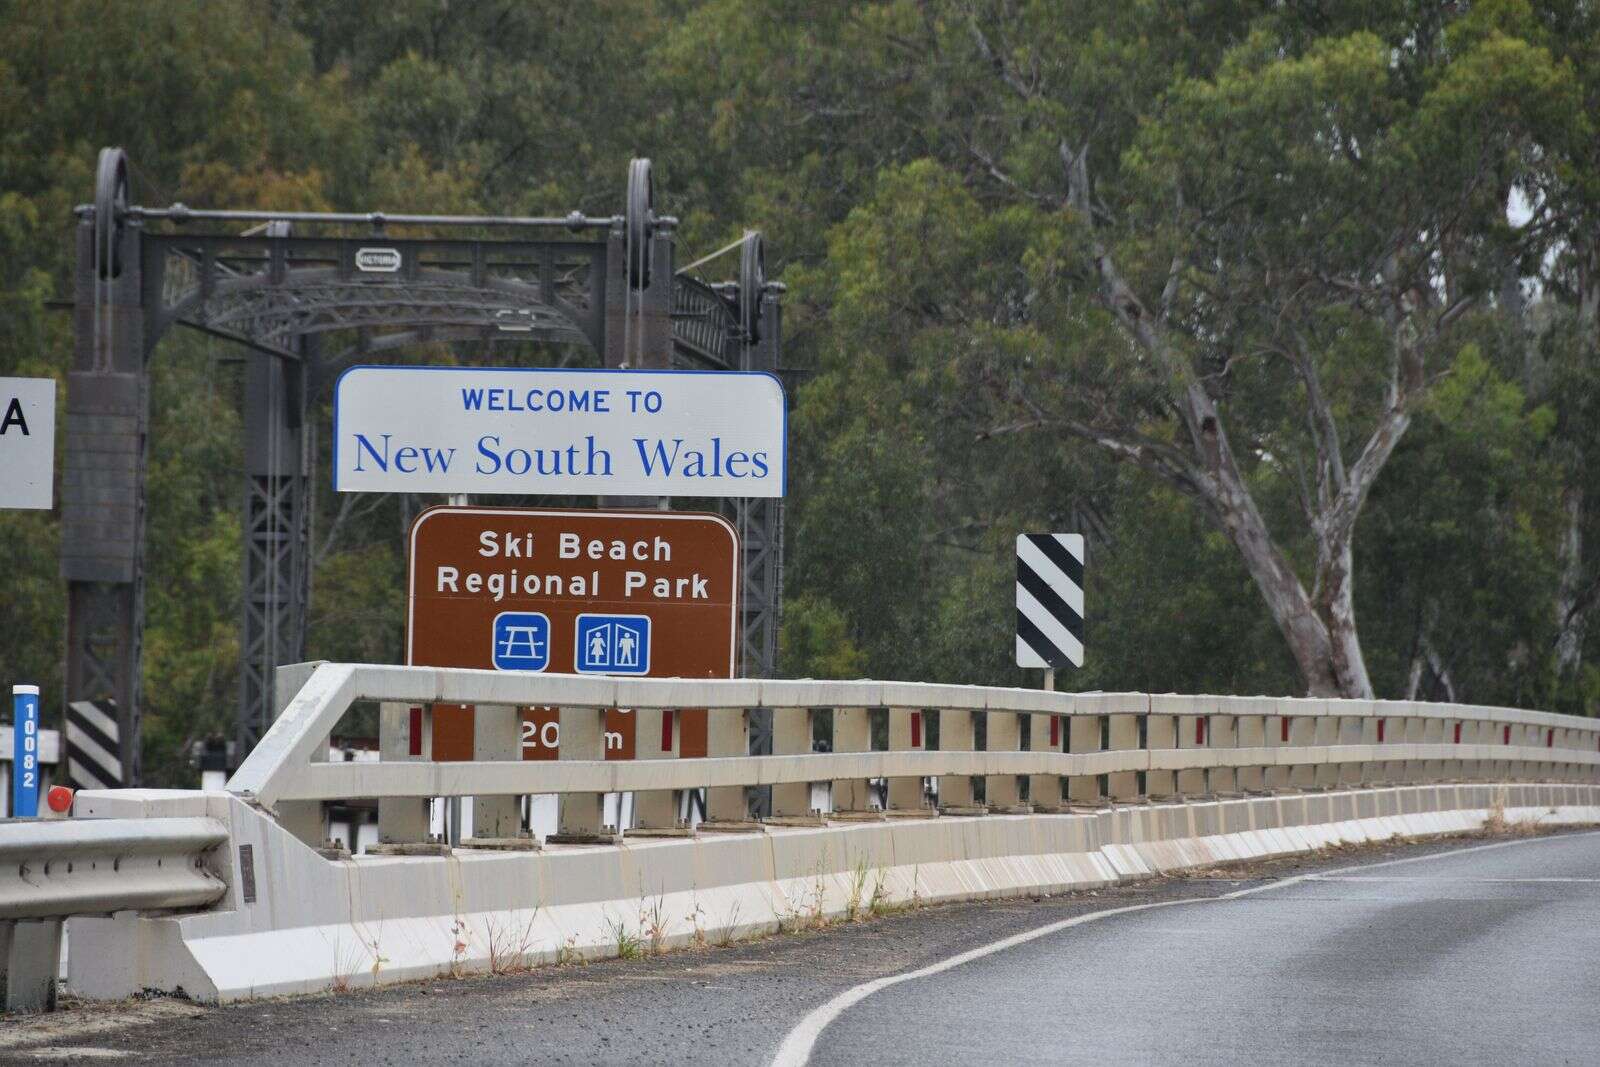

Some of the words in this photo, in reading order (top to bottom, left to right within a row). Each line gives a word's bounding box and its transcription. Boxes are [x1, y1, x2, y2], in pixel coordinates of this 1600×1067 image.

[461, 386, 609, 413] WELCOME
[626, 389, 663, 414] TO
[352, 432, 456, 474] New
[475, 434, 614, 477] South
[633, 437, 769, 479] Wales
[478, 530, 533, 558] Ski
[559, 533, 672, 562] Beach
[437, 566, 600, 601] Regional
[625, 571, 709, 599] Park
[23, 703, 36, 788] 10082
